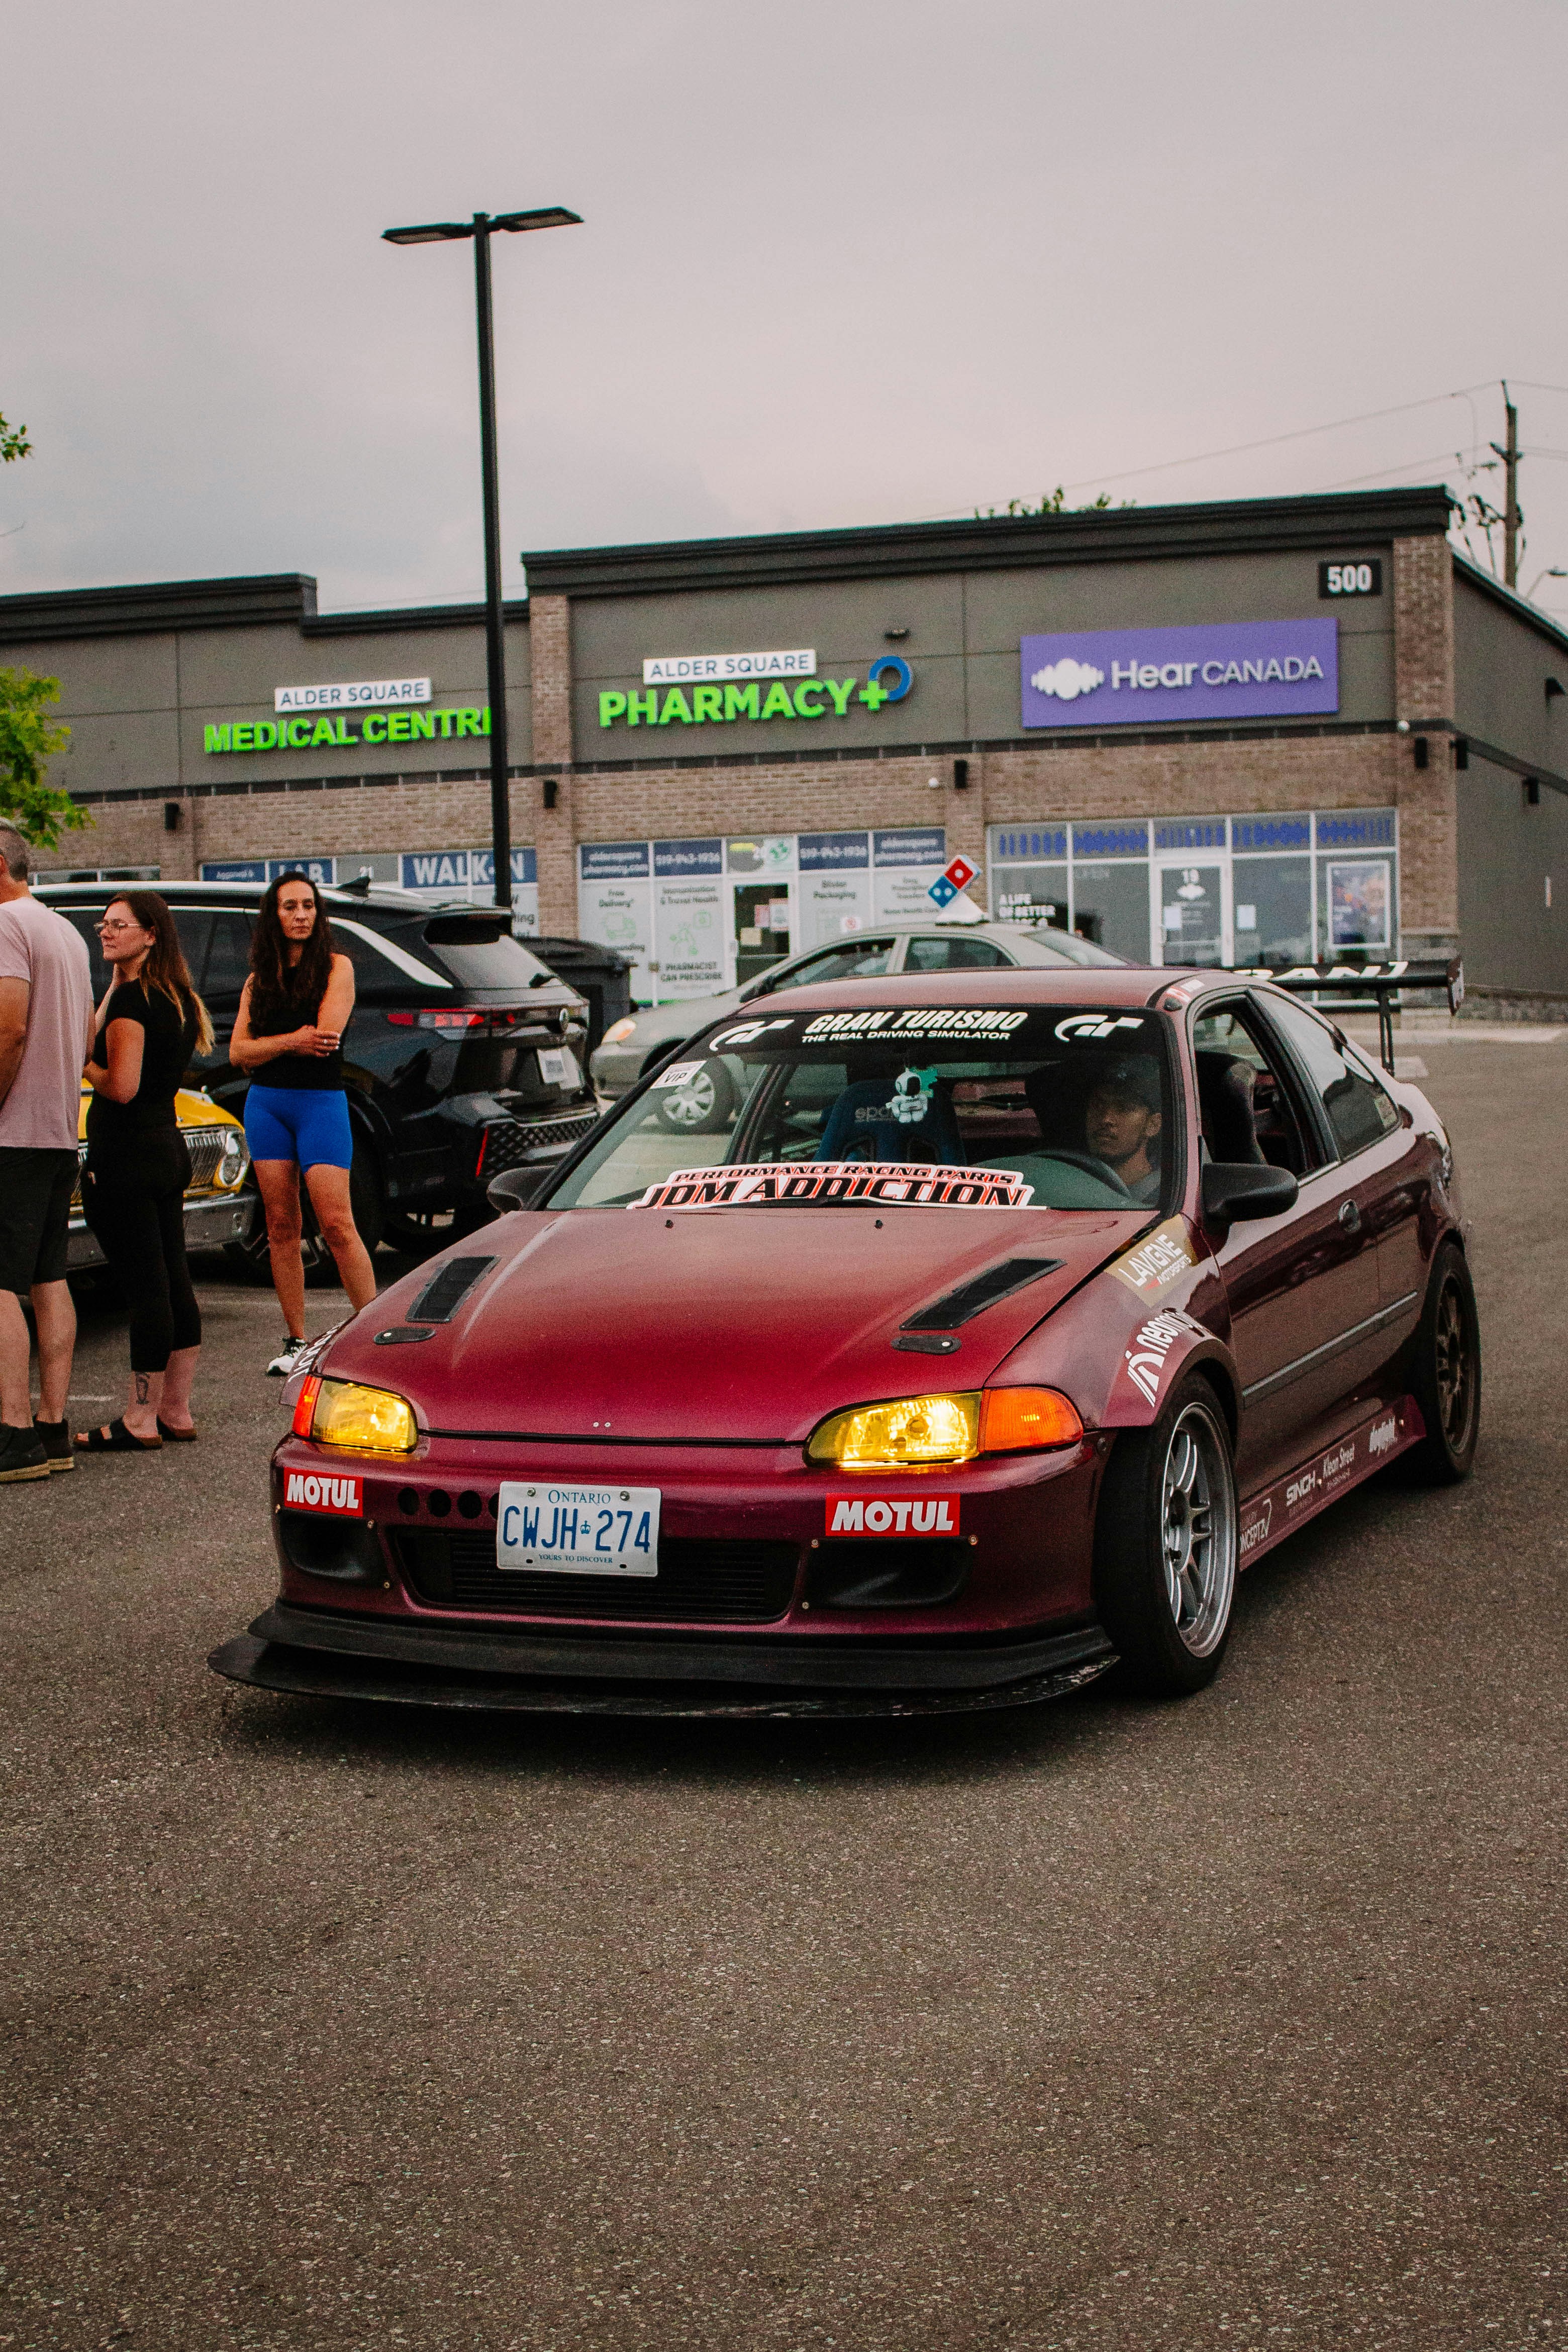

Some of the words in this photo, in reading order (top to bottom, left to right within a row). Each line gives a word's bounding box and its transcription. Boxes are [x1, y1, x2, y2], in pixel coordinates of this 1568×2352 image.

[1326, 563, 1373, 594] 500
[650, 658, 717, 677] ALDER
[725, 654, 810, 673] SQUARE
[280, 688, 341, 706] ALDER
[348, 681, 425, 702] SQUARE
[204, 717, 358, 754] MEDICAL
[413, 853, 524, 885] WALK-N
[802, 1035, 826, 1043] THE
[829, 1033, 863, 1041] REAL
[927, 1030, 1011, 1040] SIMULATOR
[805, 1012, 895, 1034] GRAN
[891, 1010, 1028, 1030] TURISMO
[664, 1072, 688, 1083] VIP
[672, 1164, 838, 1184] PERFORMANCE
[840, 1165, 931, 1178] RACING
[935, 1168, 1016, 1185] PARTS
[633, 1179, 743, 1209] JDM
[741, 1175, 1027, 1206] ADDICTION
[1118, 1234, 1183, 1287] LAVIGNE
[287, 1474, 359, 1509] MOTUL
[548, 1490, 611, 1505] ONTARIO
[595, 1509, 650, 1553] 274
[831, 1501, 954, 1532] MOTUL
